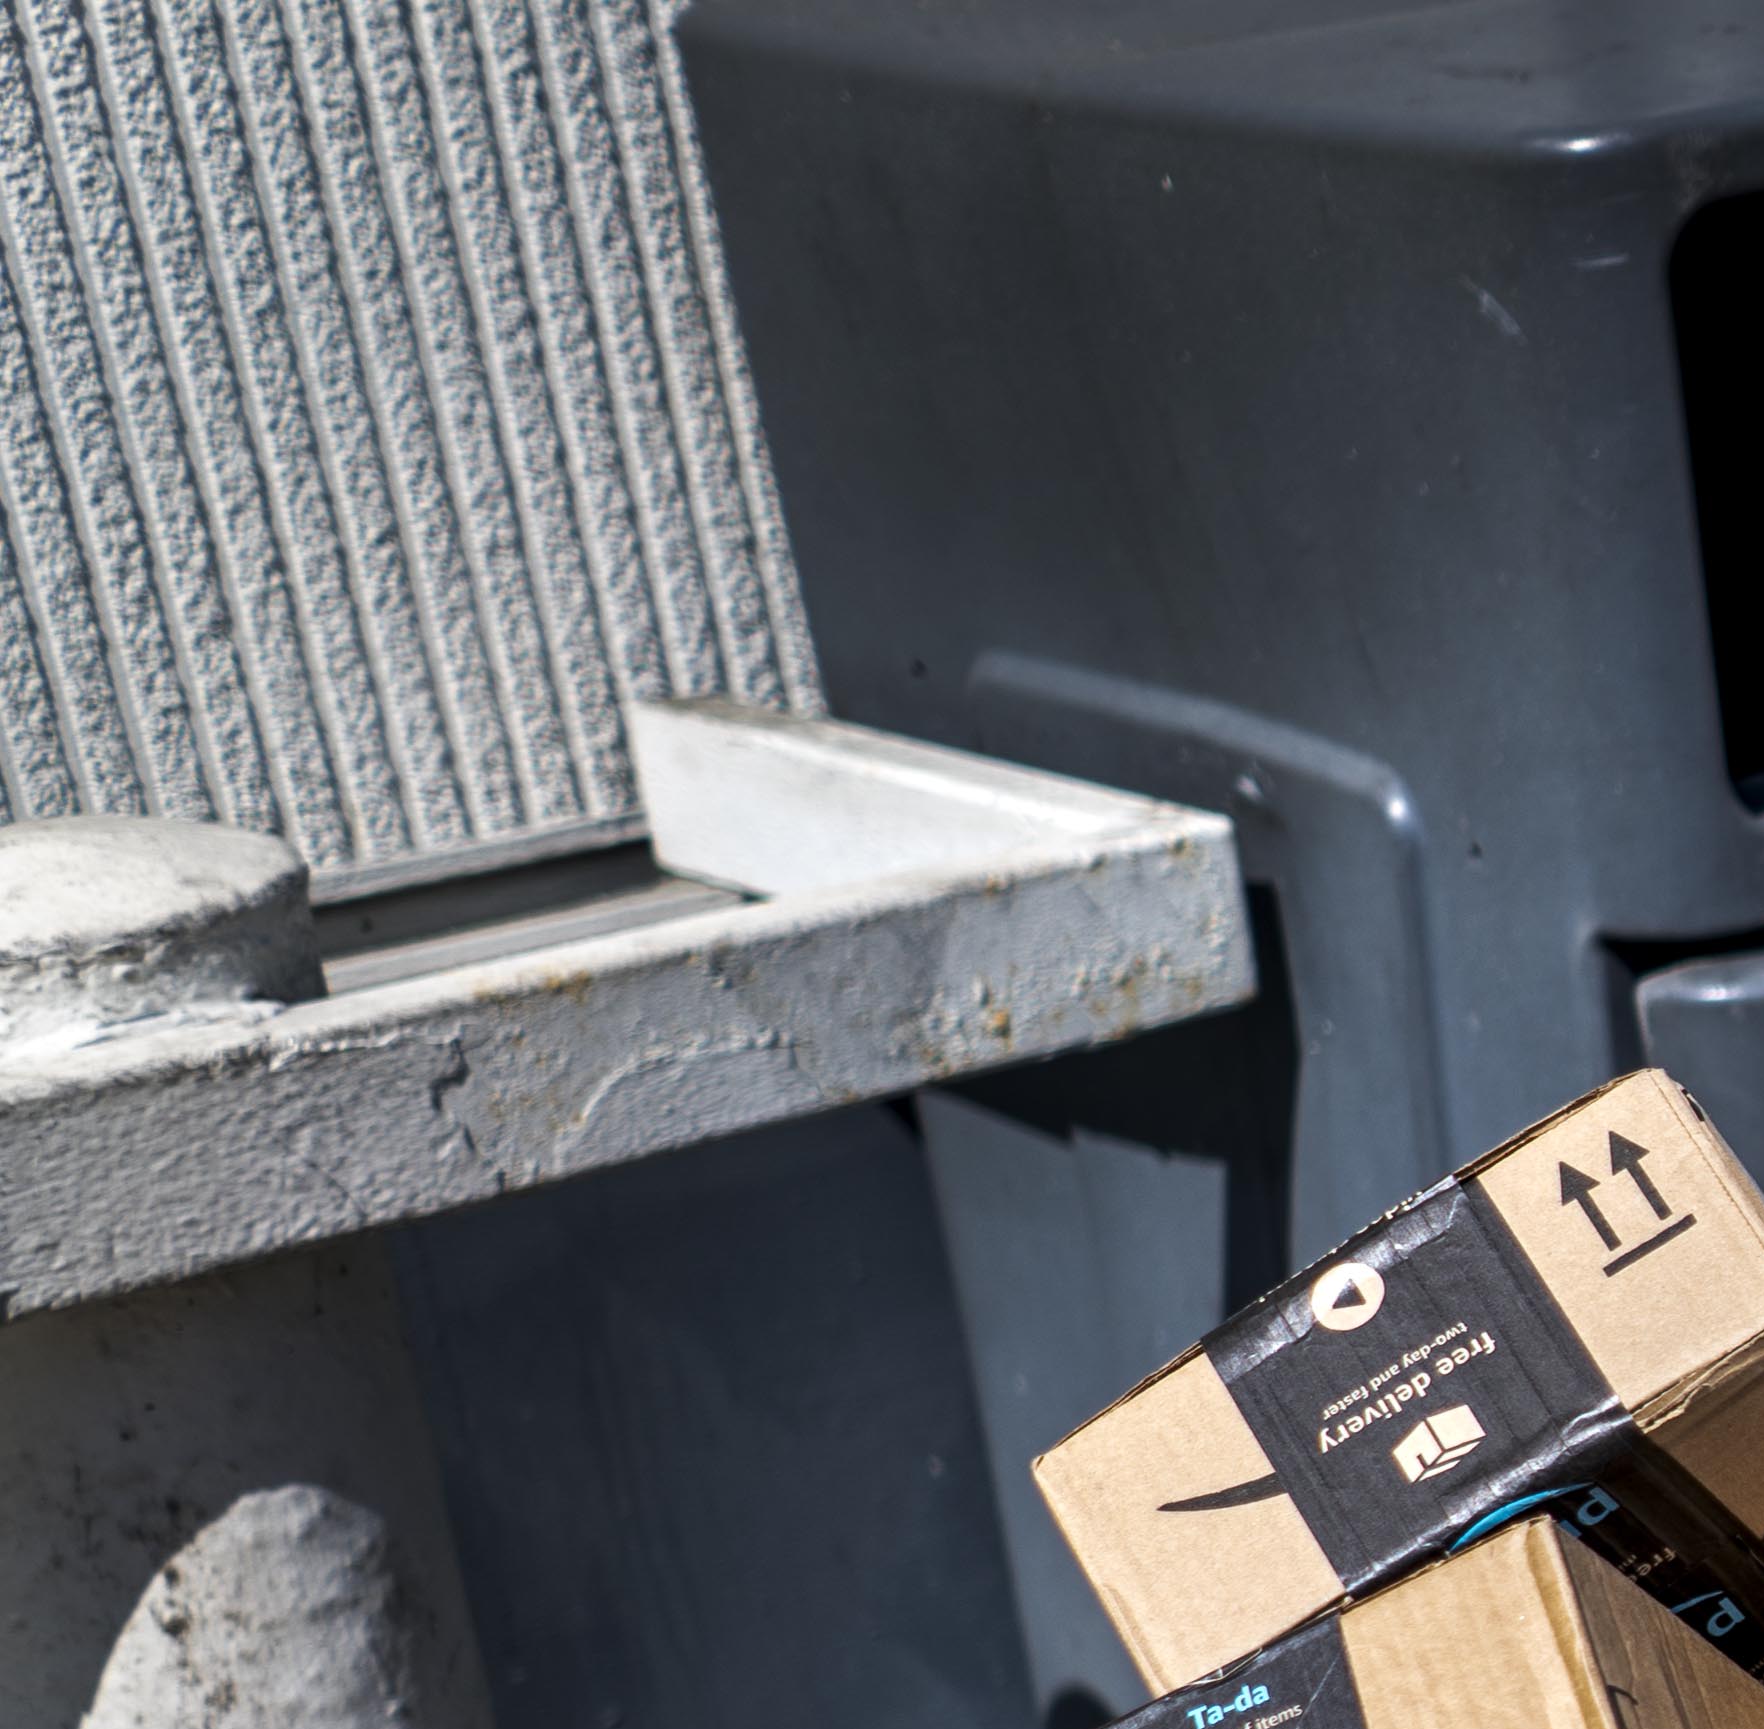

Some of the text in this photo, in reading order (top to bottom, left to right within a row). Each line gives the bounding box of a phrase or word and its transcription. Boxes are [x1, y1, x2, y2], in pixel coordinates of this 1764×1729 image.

[1319, 1332, 1496, 1454] free delivery
[1322, 1322, 1468, 1420] two-day and faster
